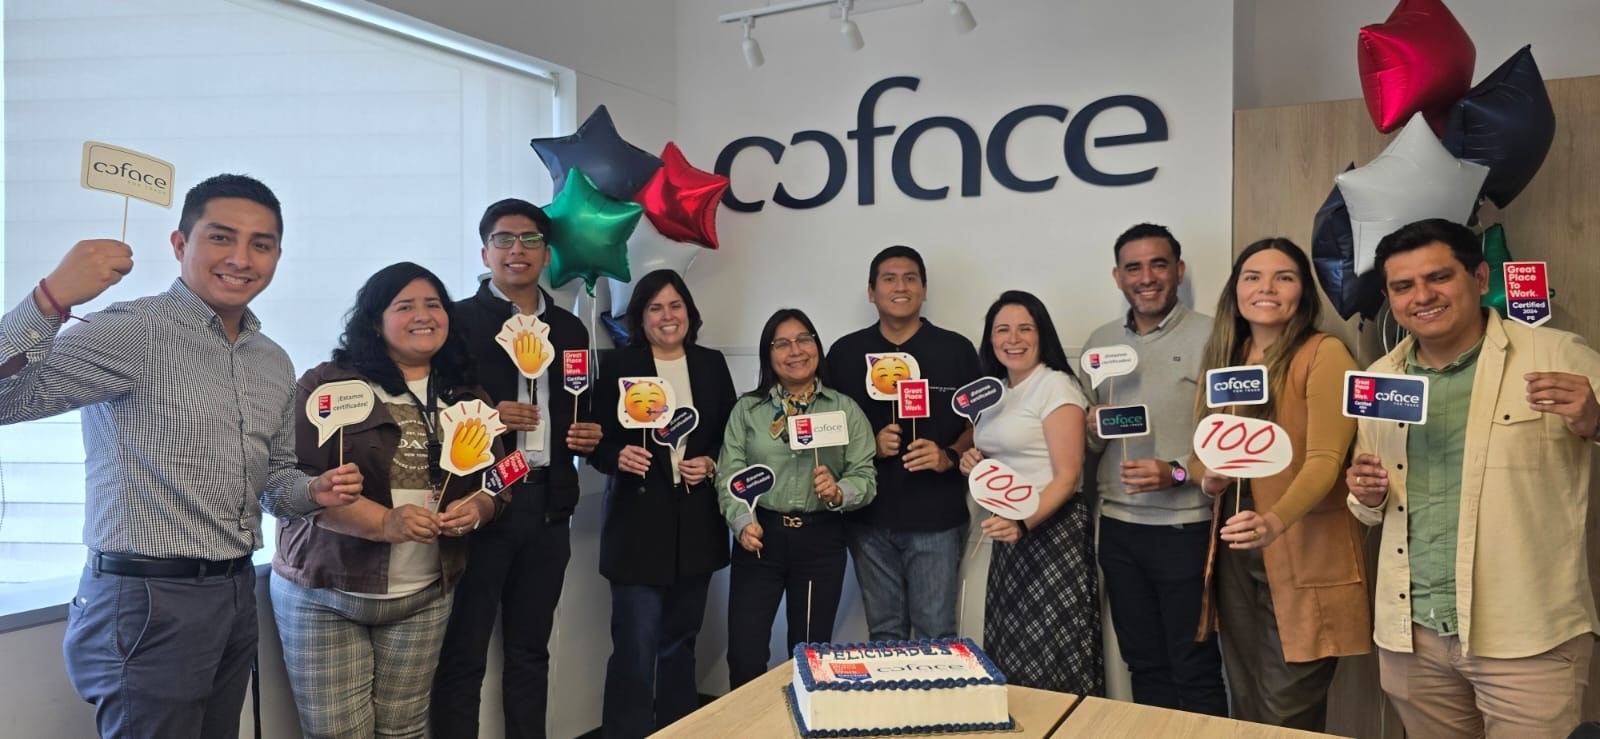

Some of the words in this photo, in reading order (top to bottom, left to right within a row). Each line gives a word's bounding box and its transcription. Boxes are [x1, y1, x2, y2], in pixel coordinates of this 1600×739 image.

[713, 76, 1168, 213] coface
[93, 161, 167, 189] coface
[1507, 265, 1536, 274] Great
[1508, 273, 1537, 281] Place
[1508, 281, 1521, 289] To
[1512, 301, 1546, 309] Certified
[1213, 377, 1261, 392] coface
[1375, 390, 1420, 404] coface
[1201, 421, 1276, 455] 100
[975, 465, 1033, 502] 100
